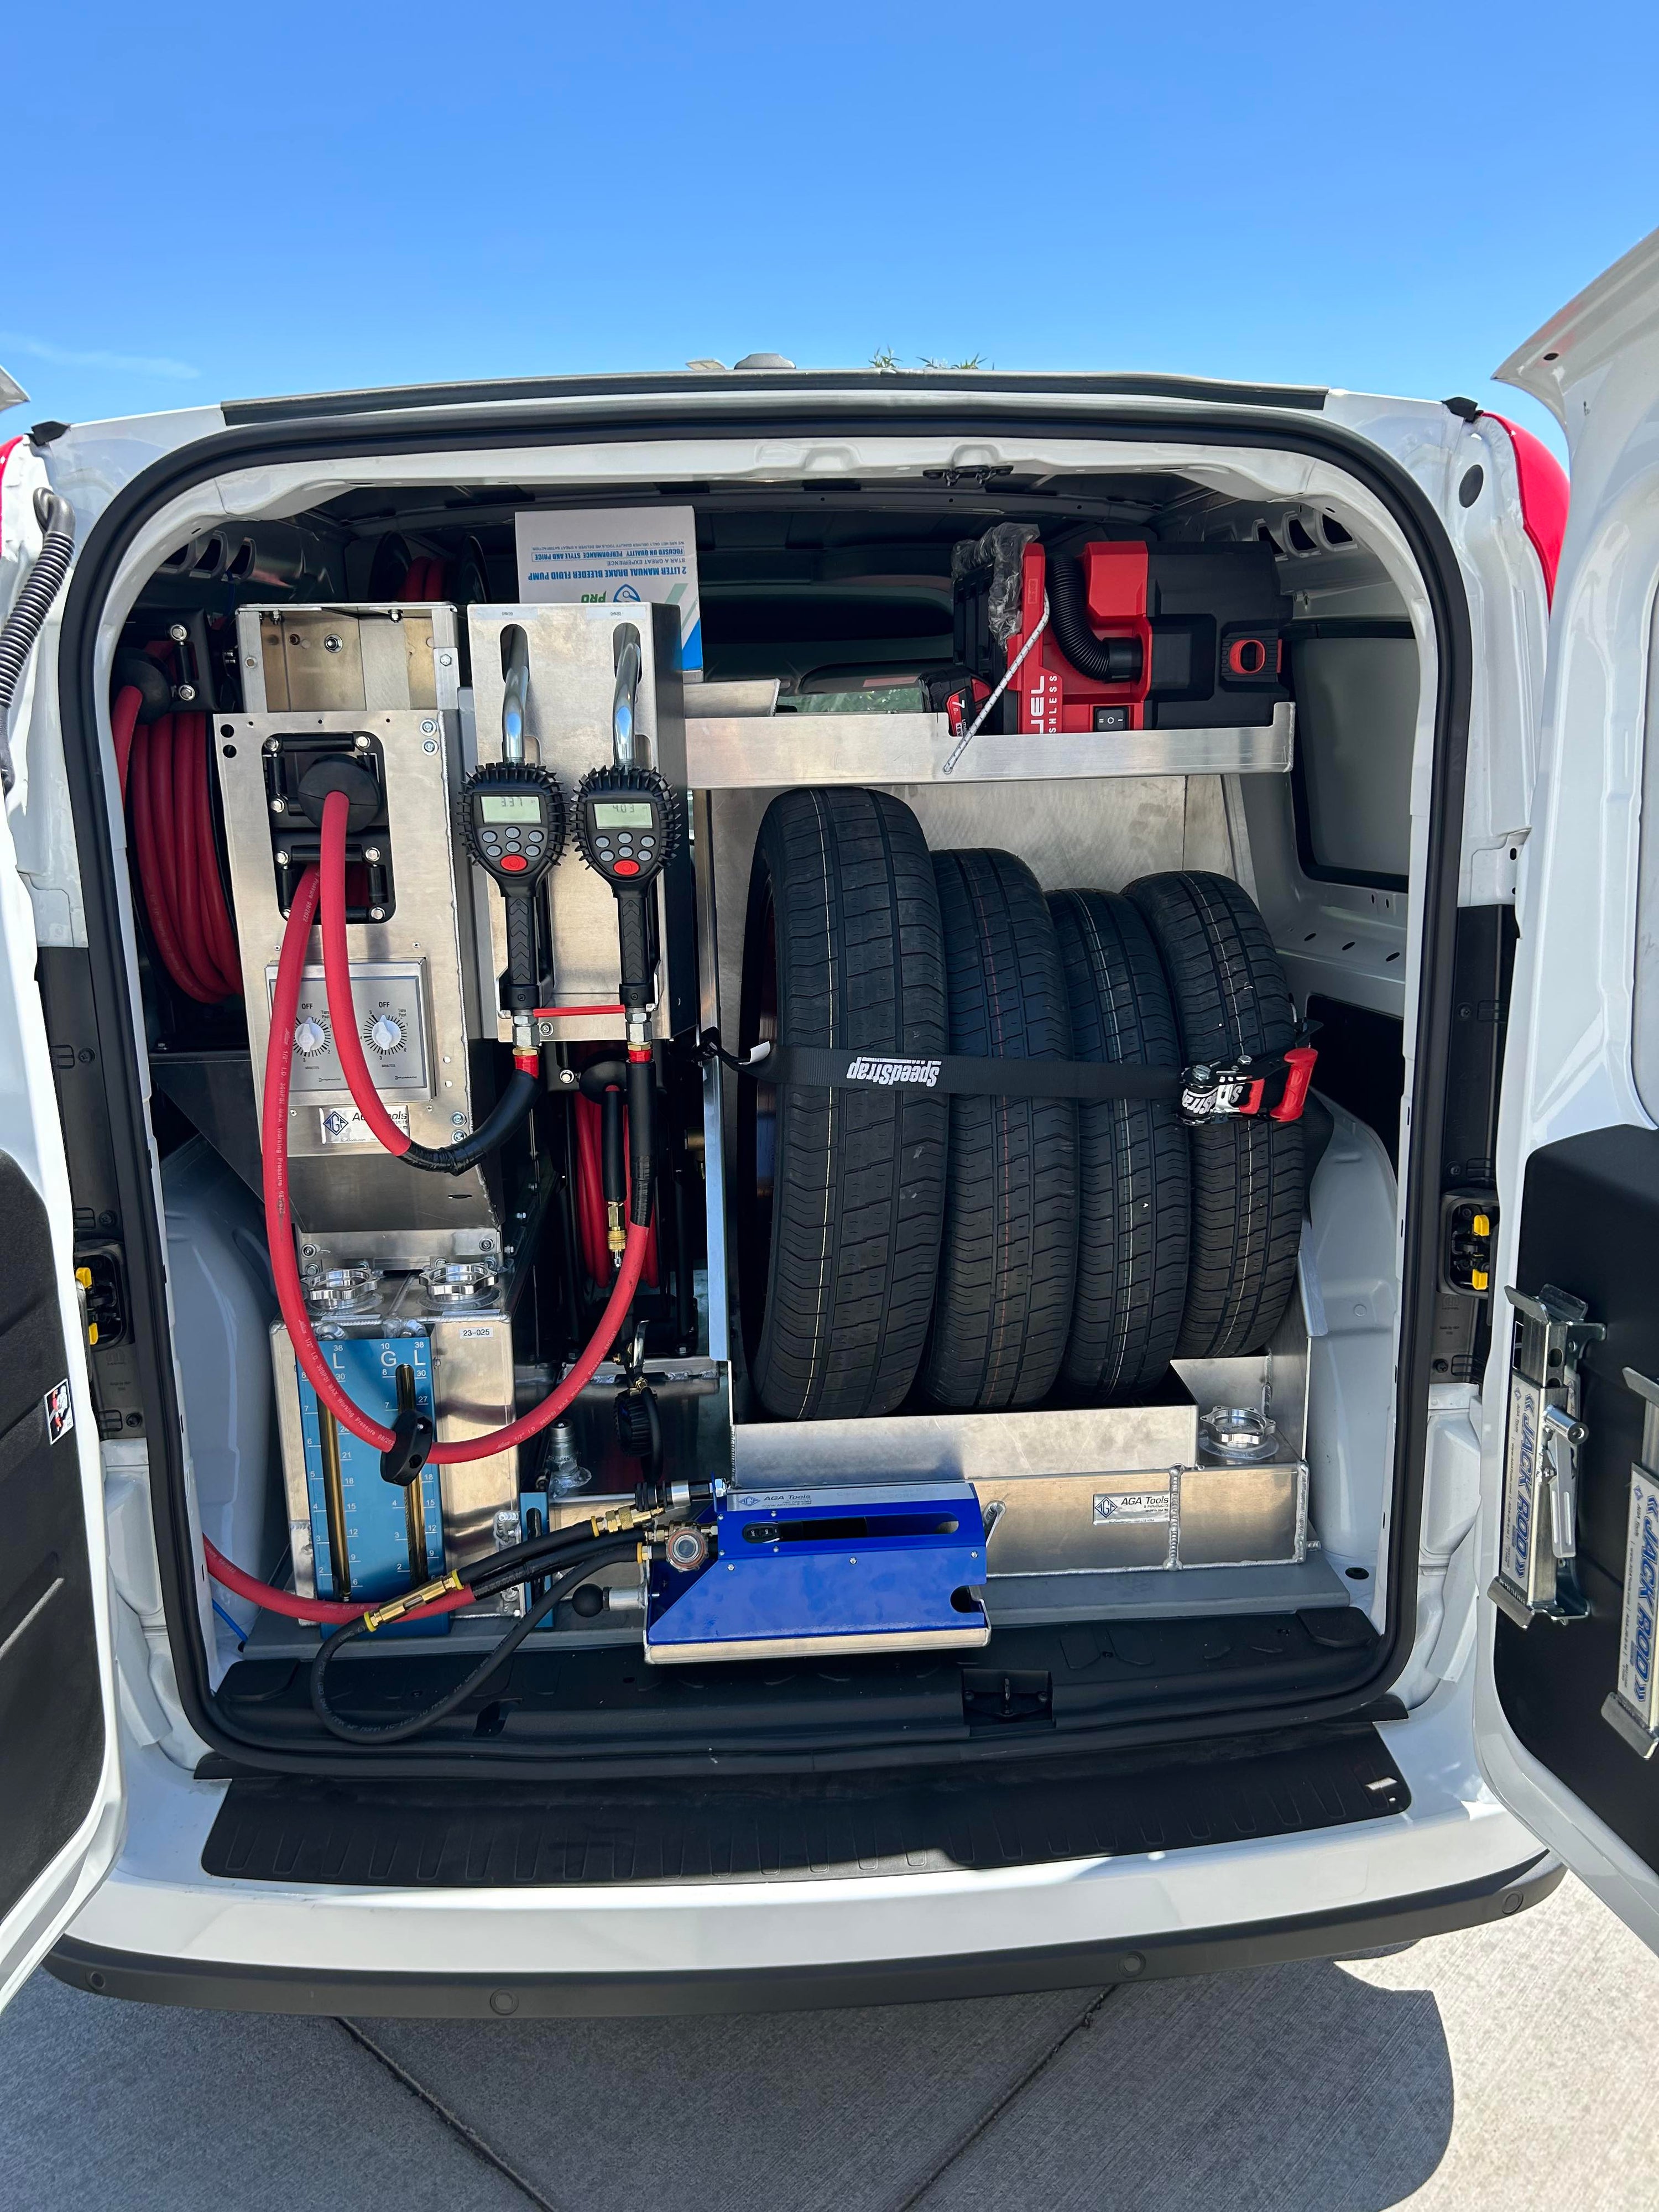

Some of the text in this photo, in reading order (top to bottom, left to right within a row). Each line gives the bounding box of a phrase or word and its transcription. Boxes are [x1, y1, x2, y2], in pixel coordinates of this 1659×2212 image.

[583, 551, 623, 559] PERFORMANCE
[528, 566, 687, 581] 2 LITER MANUAL BRAKE BLEEDER FLUID PUMP
[581, 591, 607, 603] PRO
[1031, 676, 1045, 734] UEL
[1048, 675, 1057, 733] SHLESS
[846, 1056, 942, 1087] SpeedStrap
[333, 1353, 345, 1369] L
[380, 1350, 397, 1367] G
[414, 1349, 426, 1366] L
[305, 1338, 314, 1349] 1/2"
[316, 1363, 329, 1384] 300PSI
[328, 1384, 338, 1397] MAX
[337, 1397, 354, 1418] Working
[354, 1416, 376, 1436] Pressure
[557, 1399, 570, 1411] MAX
[1515, 1412, 1535, 1559] JACK ROD
[1121, 1496, 1142, 1505] AGA
[1146, 1496, 1168, 1504] Tools
[1634, 1515, 1658, 1682] JACK ROD
